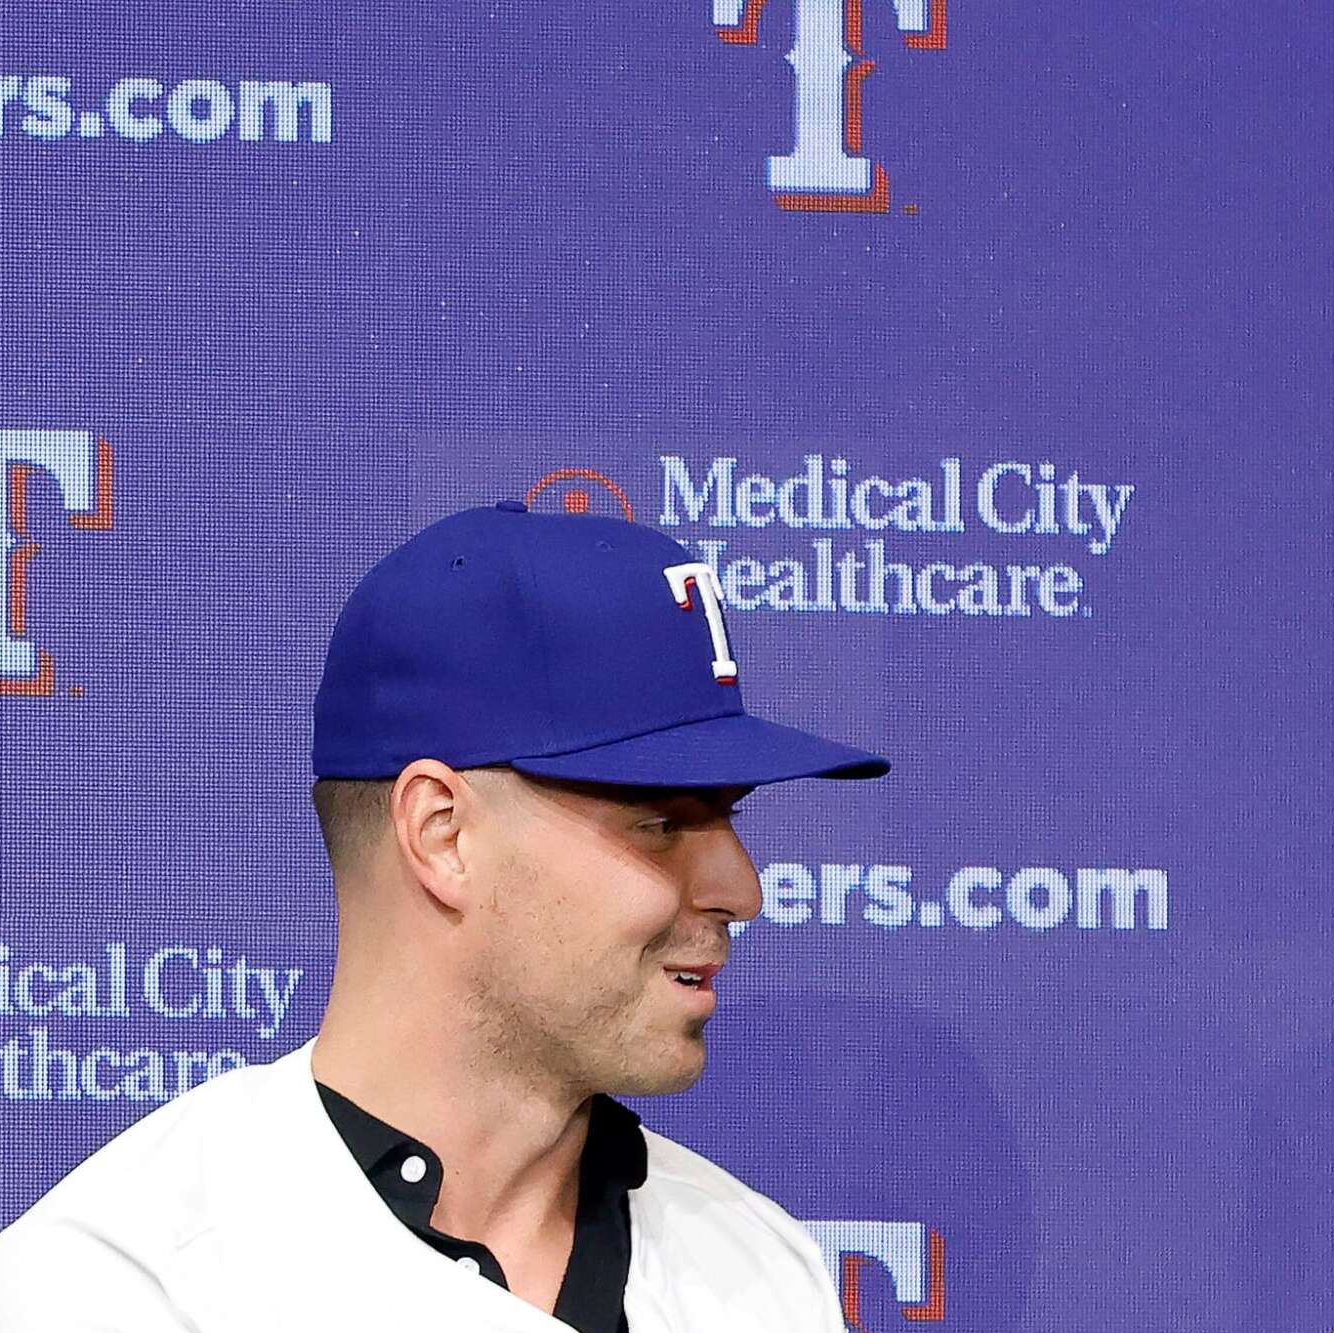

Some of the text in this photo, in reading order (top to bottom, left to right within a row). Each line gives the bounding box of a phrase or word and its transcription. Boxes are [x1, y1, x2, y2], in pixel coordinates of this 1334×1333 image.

[659, 455, 1137, 556] Medical City
[663, 563, 738, 686] T
[144, 946, 304, 1039] City
